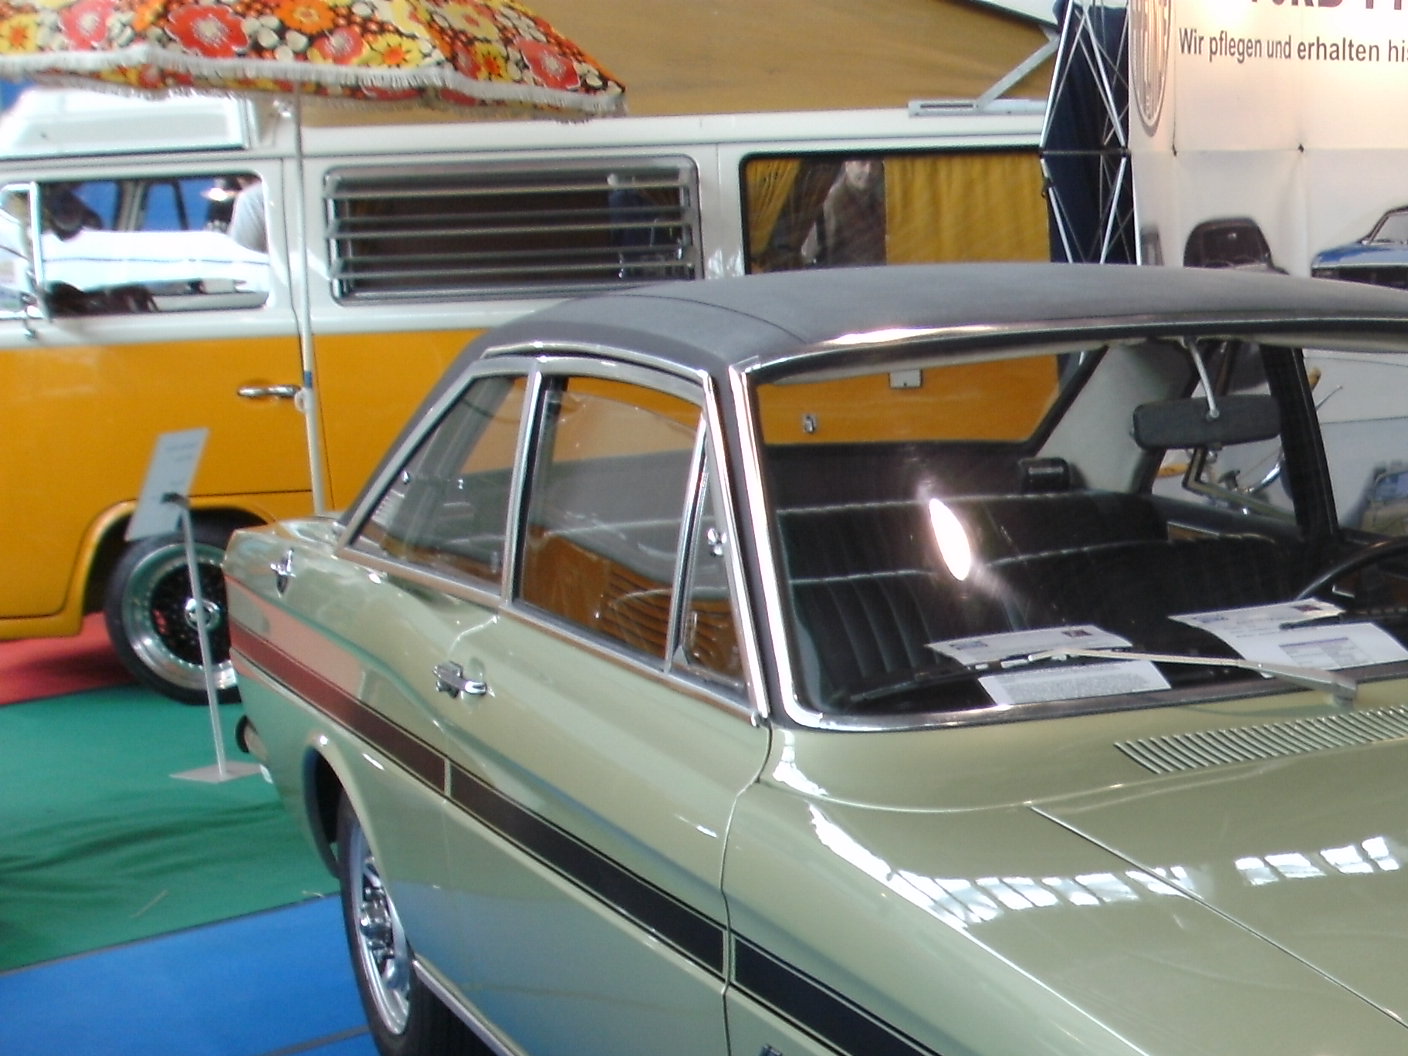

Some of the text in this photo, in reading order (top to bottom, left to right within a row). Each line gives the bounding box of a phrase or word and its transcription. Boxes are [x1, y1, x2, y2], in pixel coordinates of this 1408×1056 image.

[1178, 27, 1205, 55] Wir
[1208, 30, 1262, 64] pflegen
[1266, 35, 1292, 59] und
[1297, 36, 1380, 62] erhalten
